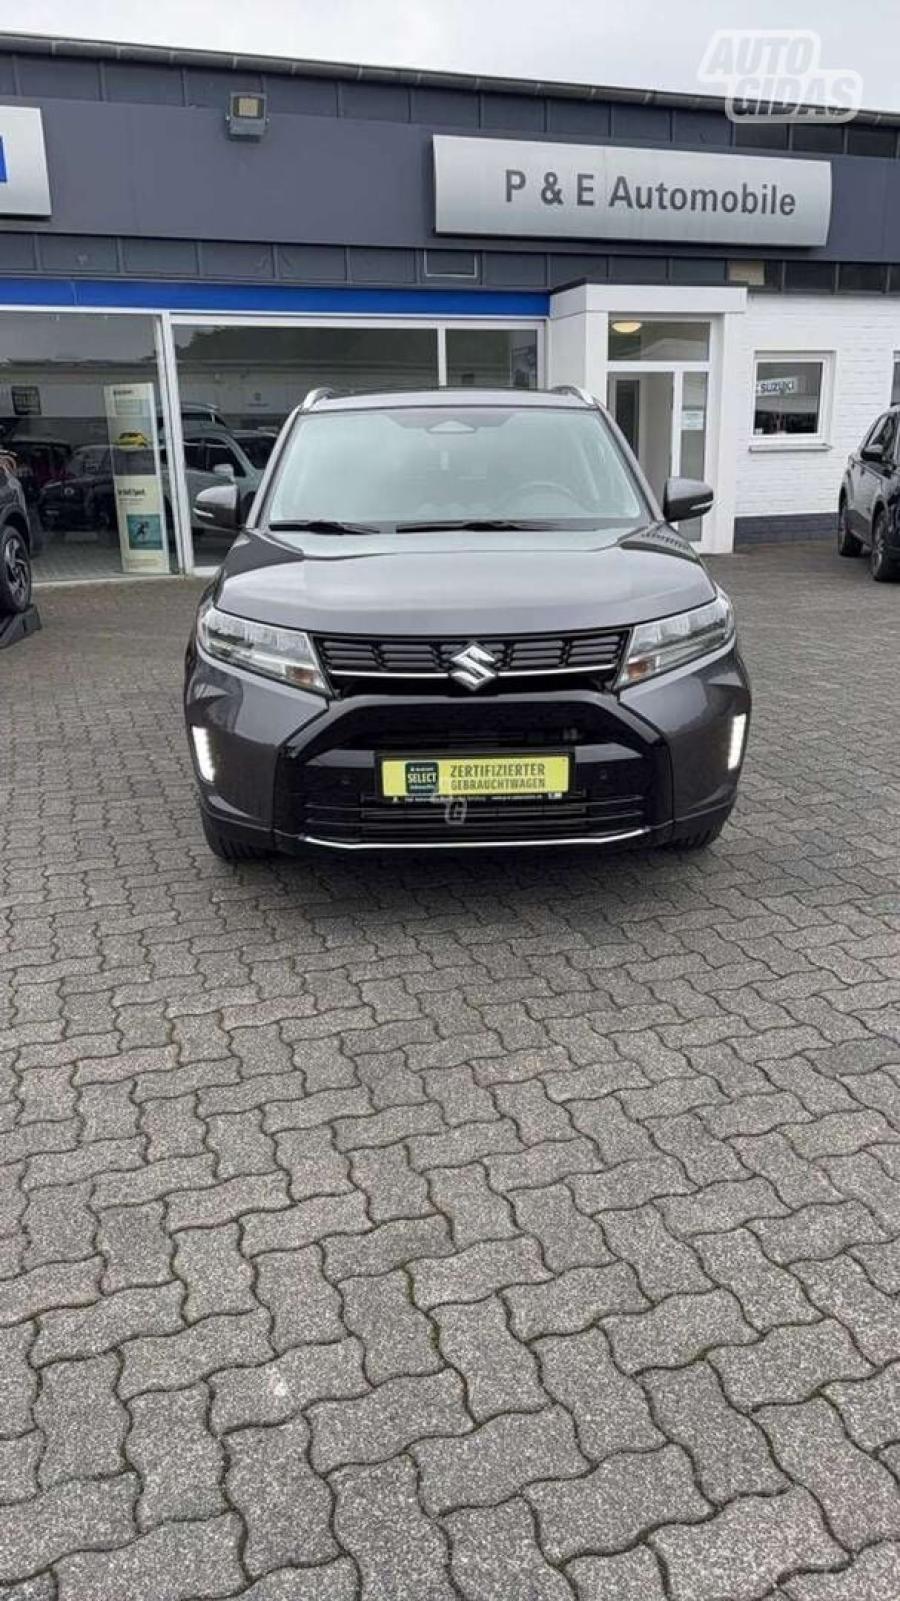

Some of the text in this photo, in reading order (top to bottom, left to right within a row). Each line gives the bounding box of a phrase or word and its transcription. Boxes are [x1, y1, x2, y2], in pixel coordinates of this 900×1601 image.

[505, 169, 796, 216] P & E Automobile
[450, 763, 546, 778] ZERTIFIZIERTER
[407, 771, 437, 785] SELECT
[450, 777, 546, 791] GEBRAUCHTWAGEN
